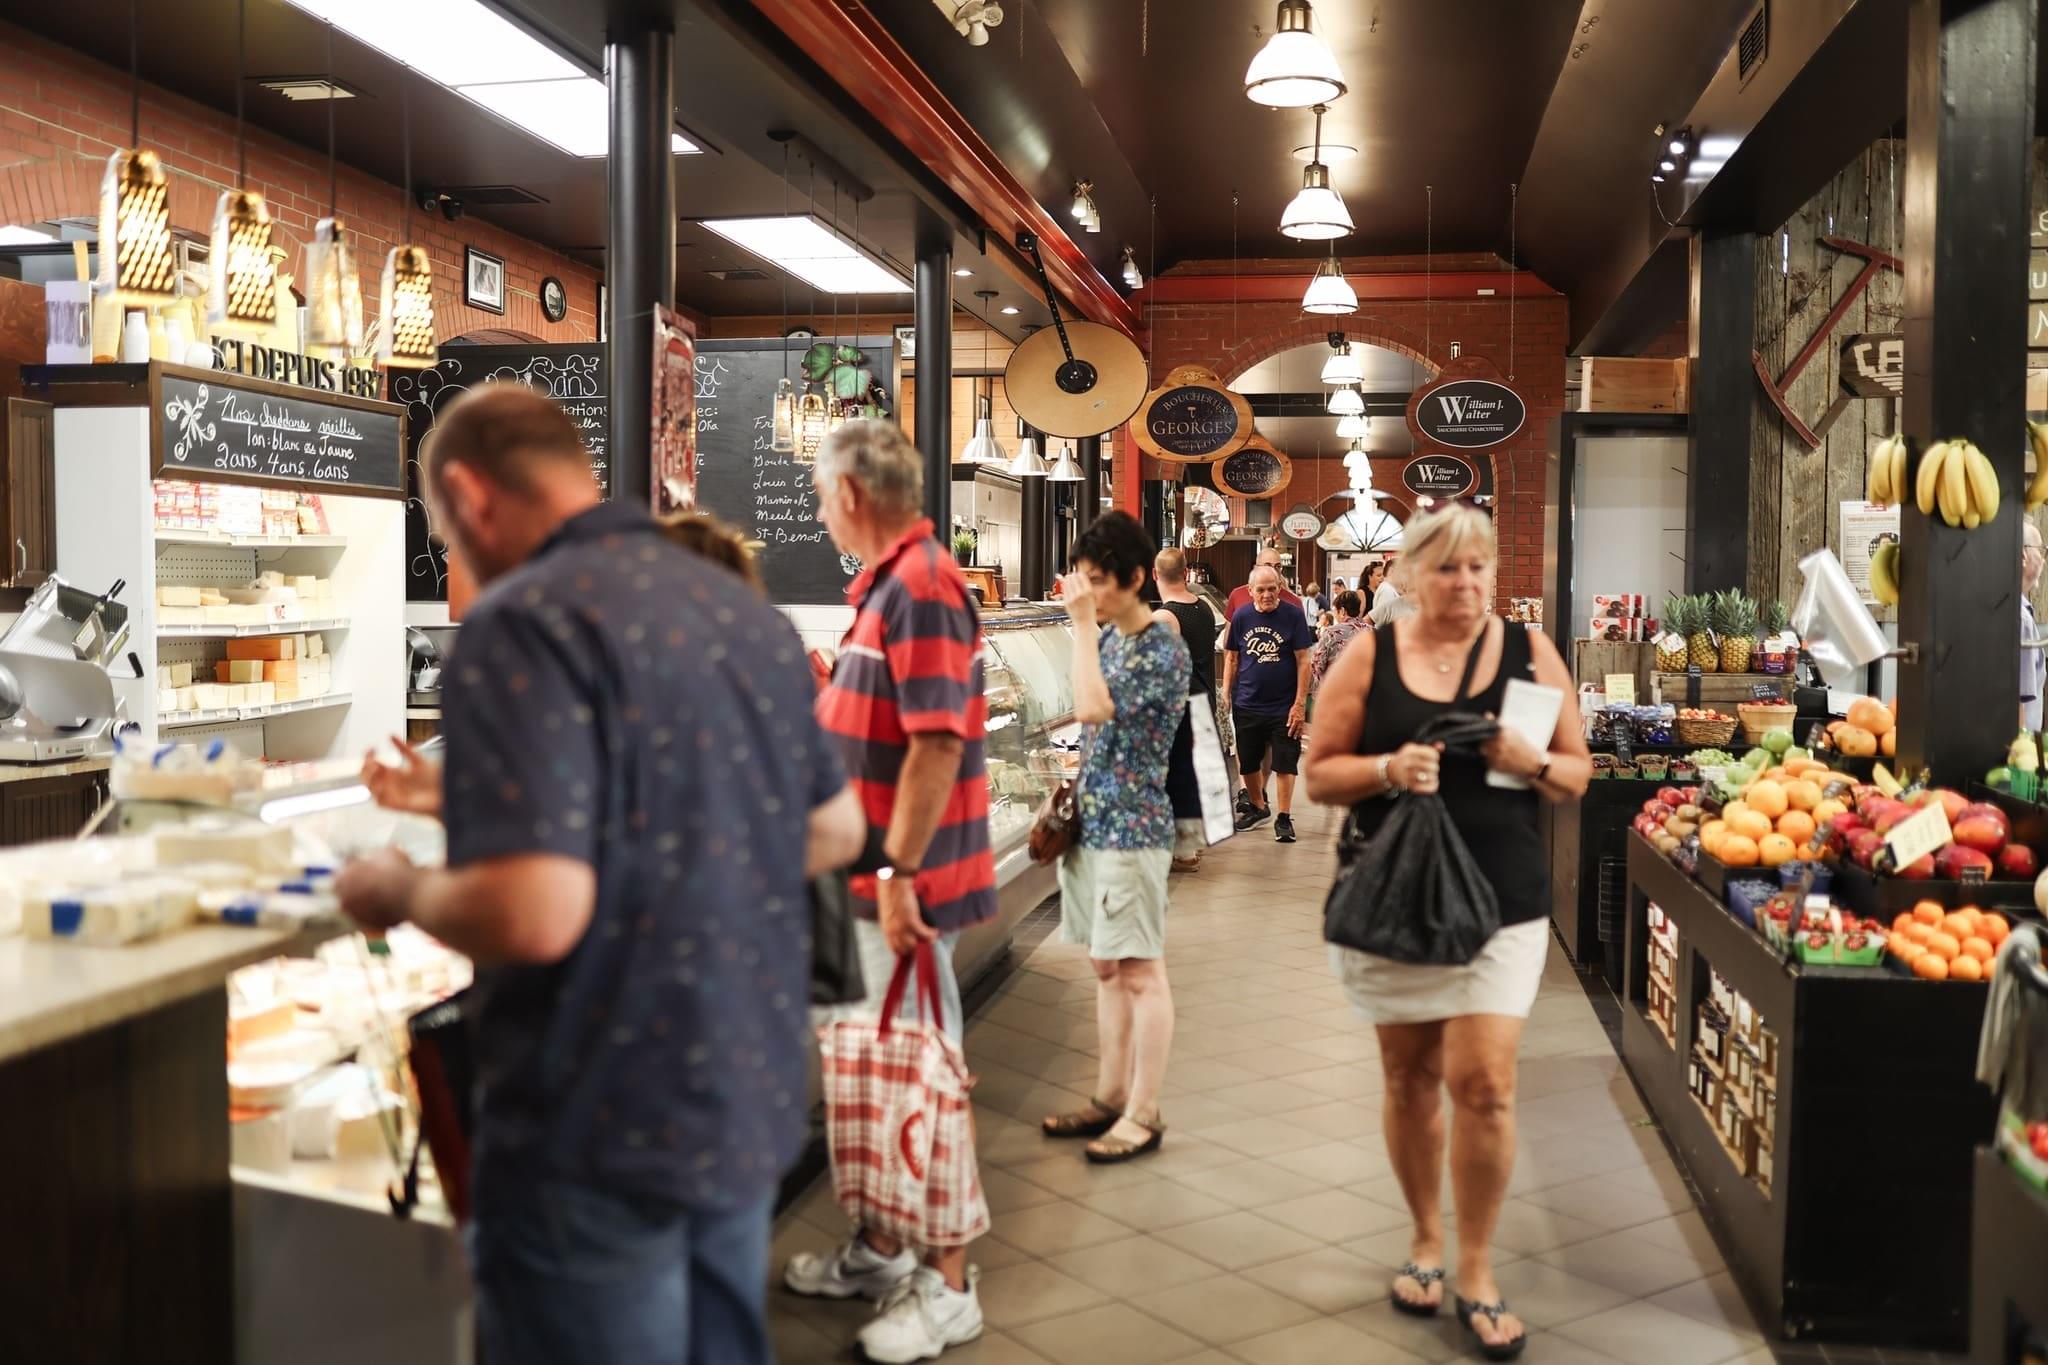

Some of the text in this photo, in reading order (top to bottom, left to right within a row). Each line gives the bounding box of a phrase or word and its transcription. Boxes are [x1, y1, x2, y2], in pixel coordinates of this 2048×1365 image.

[211, 335, 384, 400] ICI DEPUIS 1987
[216, 391, 255, 422] Nos
[1152, 420, 1233, 436] GEORGES
[313, 459, 350, 480] 6ans
[1246, 637, 1280, 656] Lois
